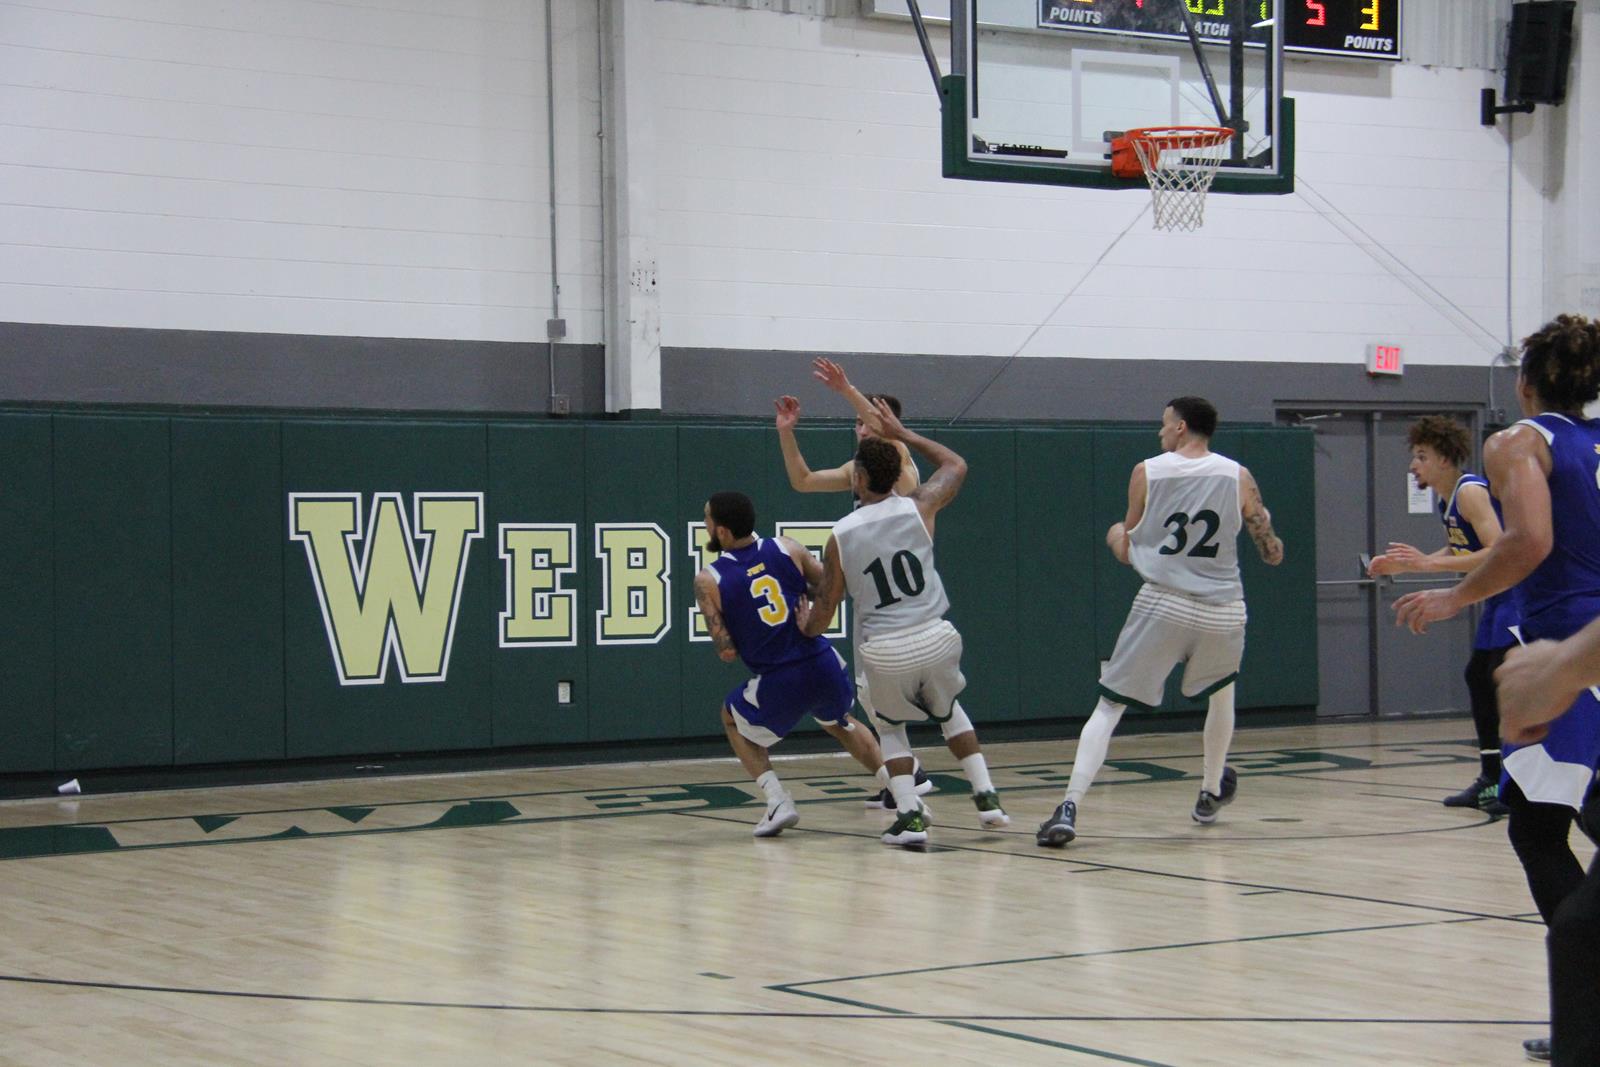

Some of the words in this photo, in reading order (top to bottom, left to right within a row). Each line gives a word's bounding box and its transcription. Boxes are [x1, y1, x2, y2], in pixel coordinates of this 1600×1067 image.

[1050, 6, 1103, 25] POINTS
[1360, 0, 1380, 31] 3
[1343, 35, 1393, 52] POINTS
[1376, 345, 1401, 371] EXIT
[1159, 509, 1221, 558] 32
[863, 549, 926, 610] 10
[750, 574, 789, 627] 3
